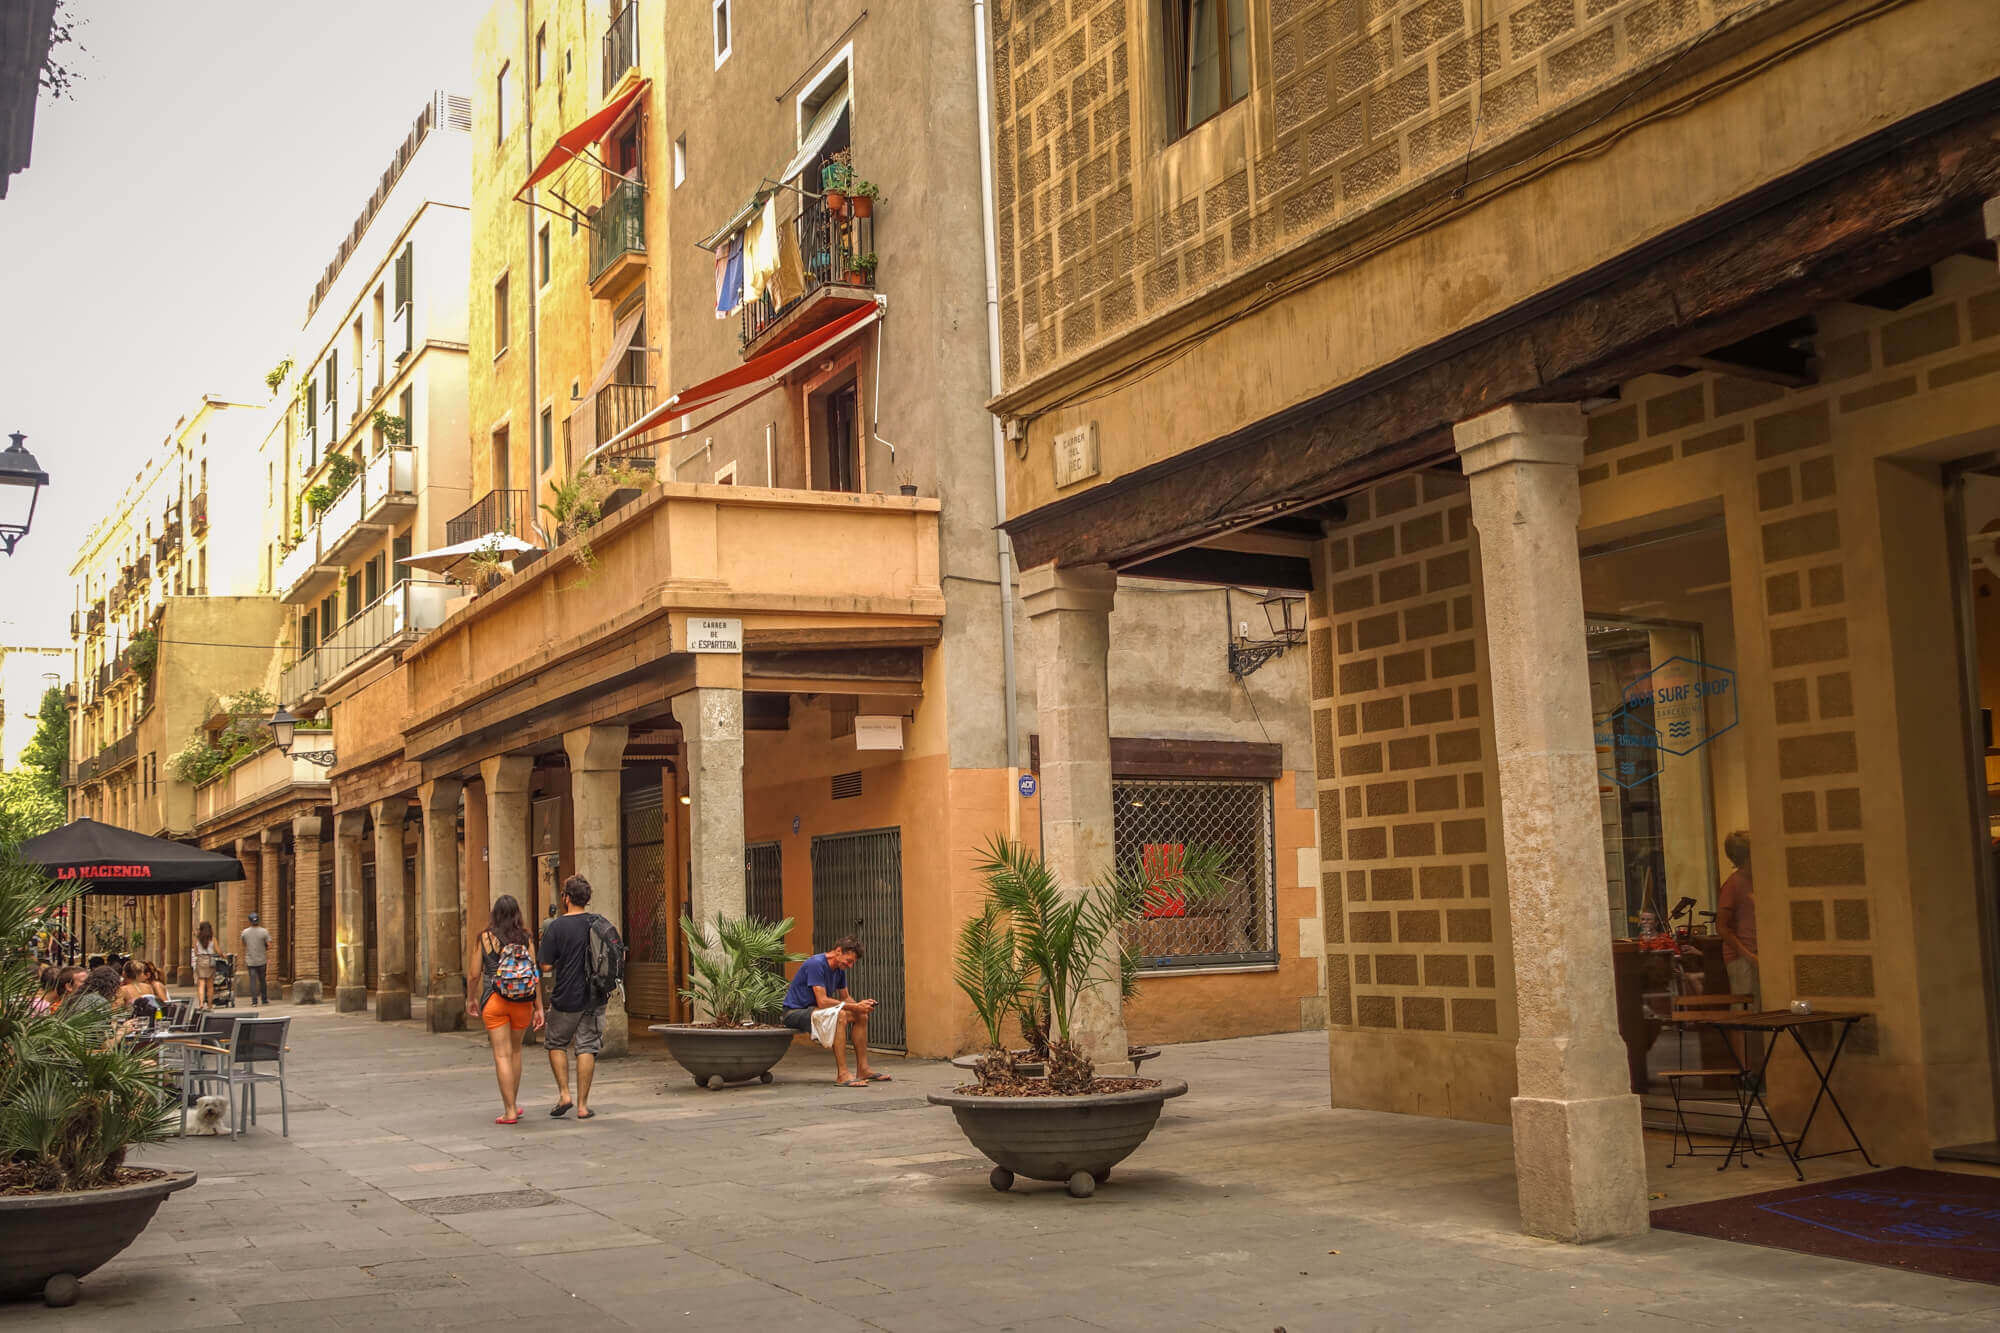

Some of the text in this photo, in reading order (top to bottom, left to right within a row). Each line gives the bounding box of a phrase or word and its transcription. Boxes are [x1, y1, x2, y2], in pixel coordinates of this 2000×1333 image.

[698, 640, 737, 649] ESPARTERIA
[1630, 678, 1729, 708] BOX SURF SHOP
[1020, 780, 1034, 789] ADT
[57, 865, 151, 880] LA HACIENDA
